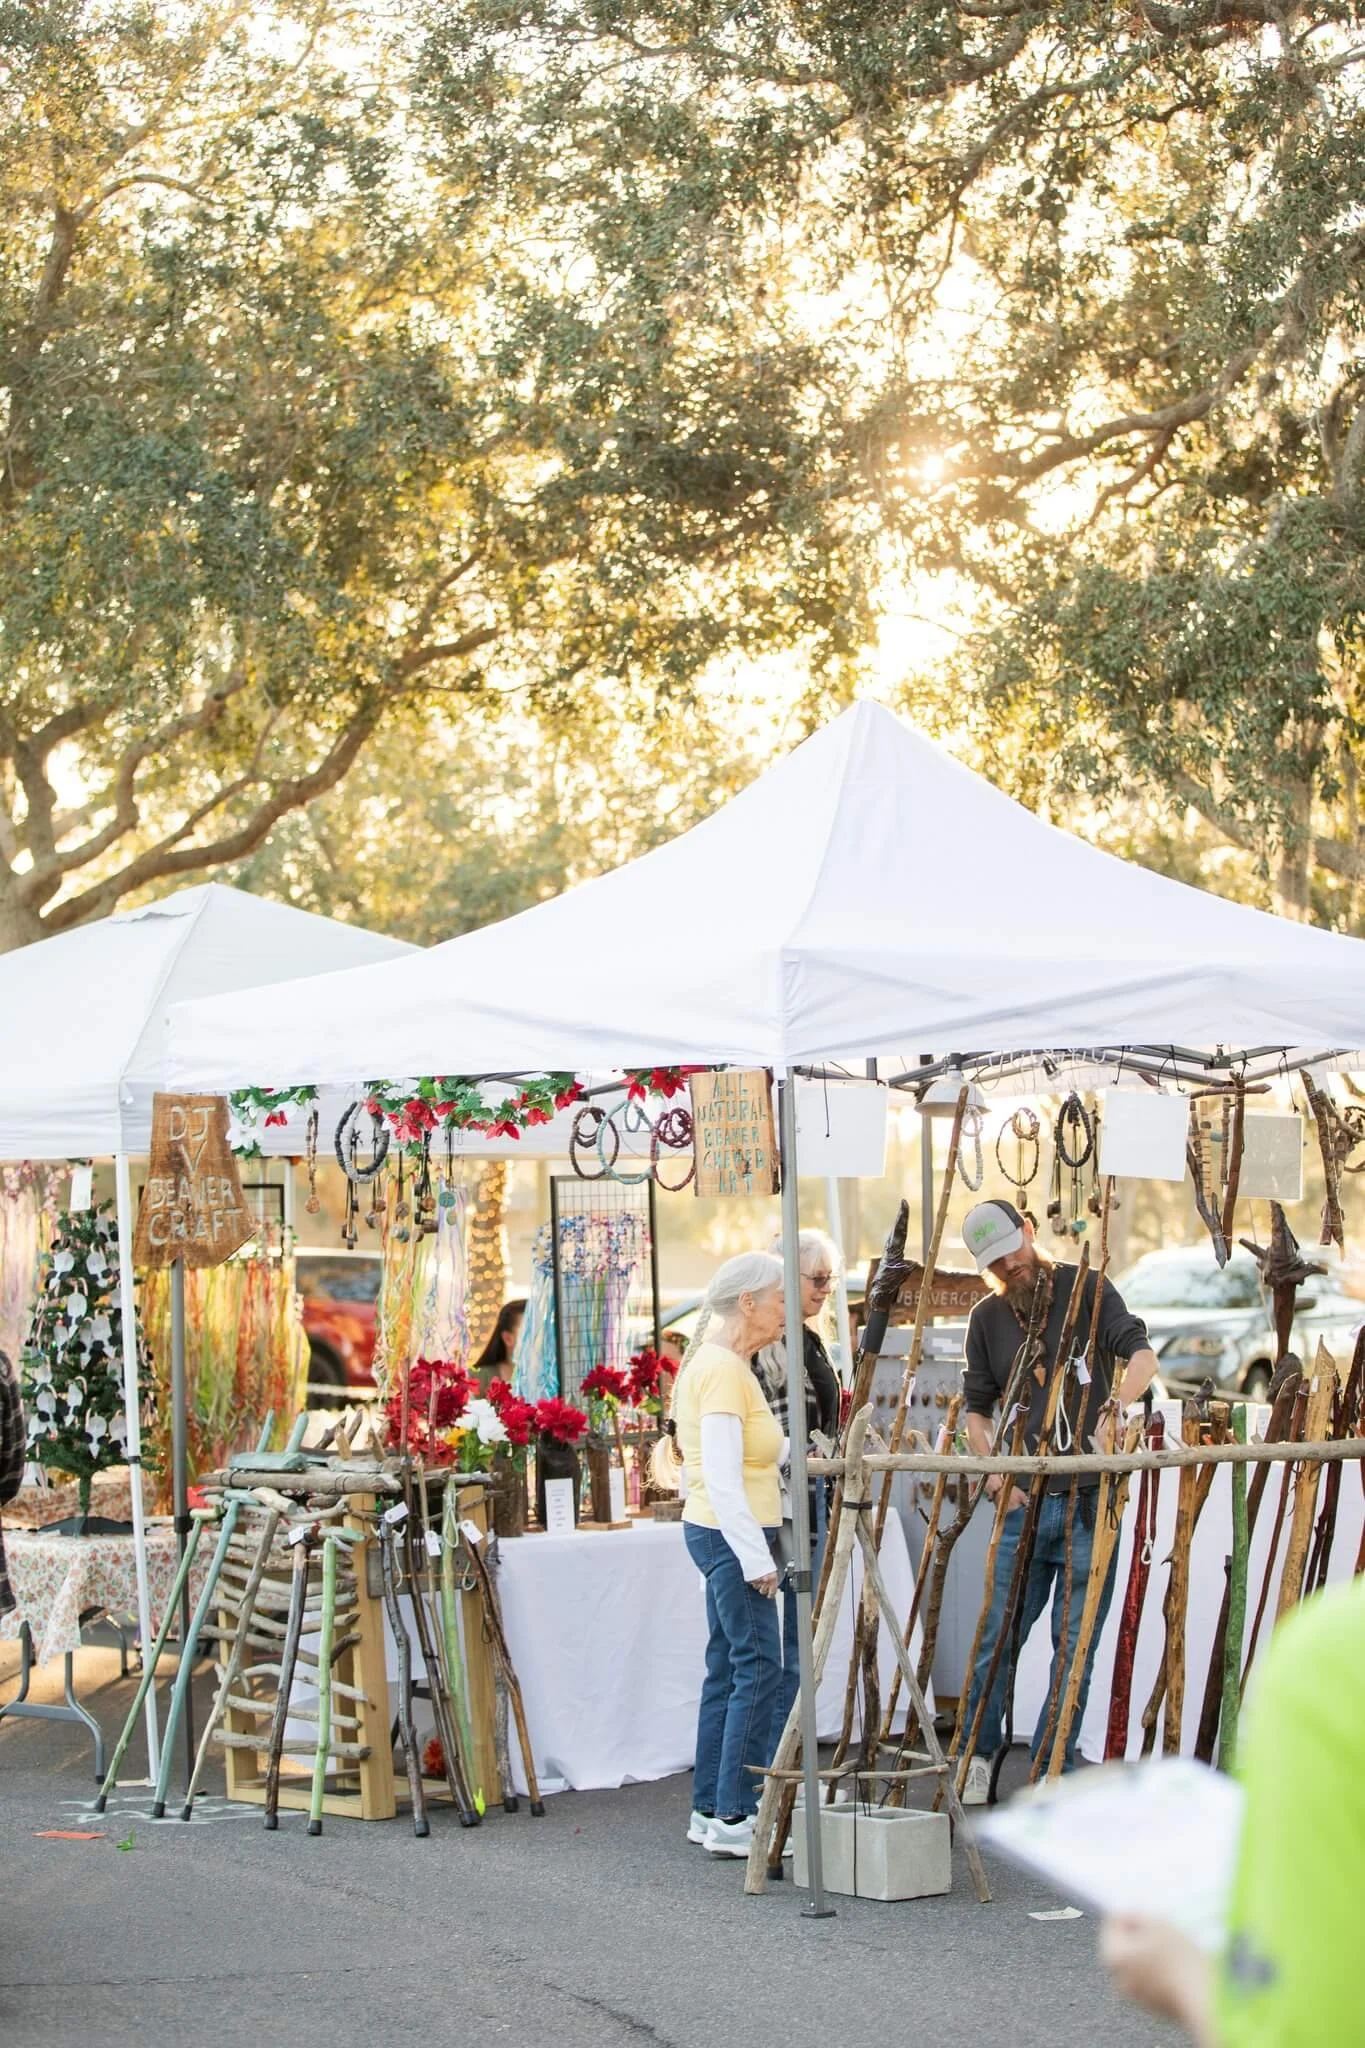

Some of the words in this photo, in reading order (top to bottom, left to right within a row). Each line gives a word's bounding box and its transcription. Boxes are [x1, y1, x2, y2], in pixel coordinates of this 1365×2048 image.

[713, 1073, 749, 1098] ALL
[169, 1105, 216, 1141] DJ
[697, 1097, 767, 1122] NATURAL
[149, 1175, 236, 1210] BEAVER
[719, 1169, 753, 1193] ART
[149, 1208, 242, 1246] CRAFT
